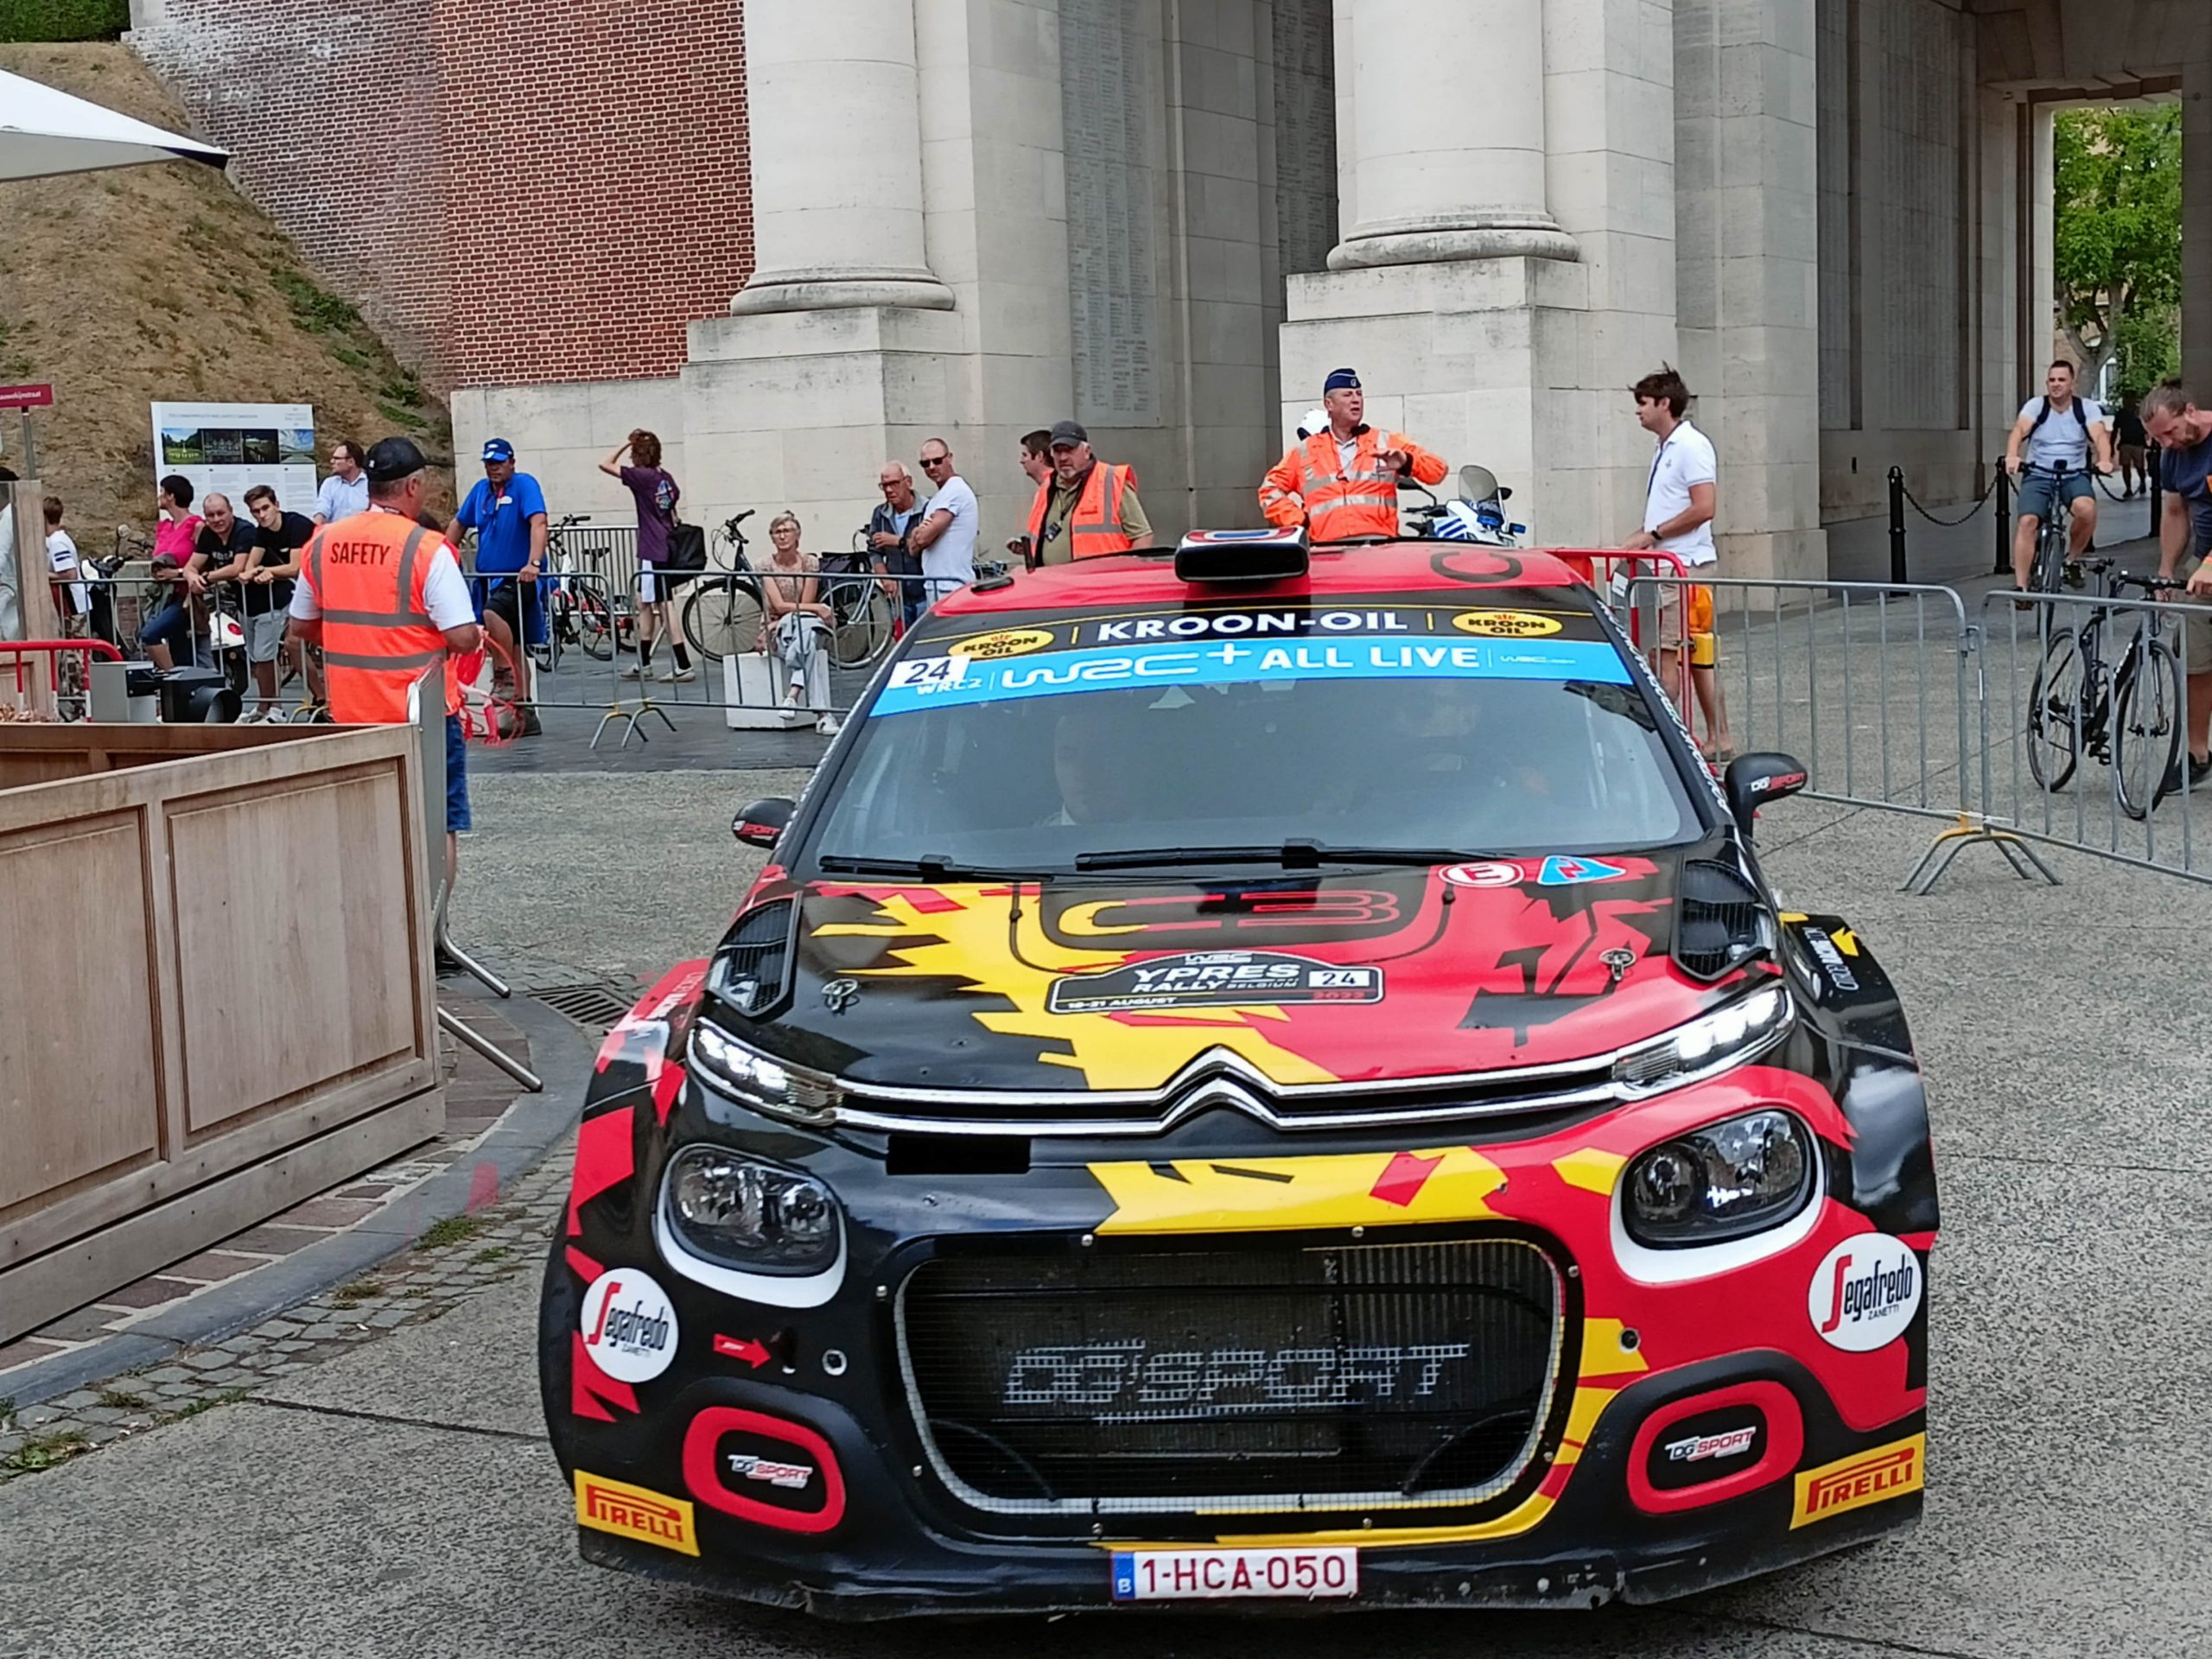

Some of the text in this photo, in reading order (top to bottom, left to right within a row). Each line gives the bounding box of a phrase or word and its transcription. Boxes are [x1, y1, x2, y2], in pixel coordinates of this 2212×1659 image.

[330, 542, 391, 565] SAFETY
[1097, 611, 1408, 641] KROON-OIL
[1469, 619, 1546, 629] KROON
[963, 636, 1039, 652] KROON
[981, 646, 1014, 657] OIL
[1259, 647, 1354, 671] ALL
[1370, 646, 1480, 668] LIVE
[904, 658, 951, 684] 24
[917, 677, 982, 696] WRC2
[1135, 964, 1300, 982] YPRES
[1321, 972, 1356, 986] 24
[1131, 980, 1299, 993] RALLY BELGIUM
[1109, 997, 1177, 1007] AUGUST
[1821, 1254, 1913, 1333] Segafredo
[1868, 1306, 1900, 1320] ZANETTI
[1806, 1447, 1915, 1514] PIRELLI
[587, 1484, 683, 1542] PIRELLI
[1117, 1555, 1345, 1593] B 1-HCA-050
